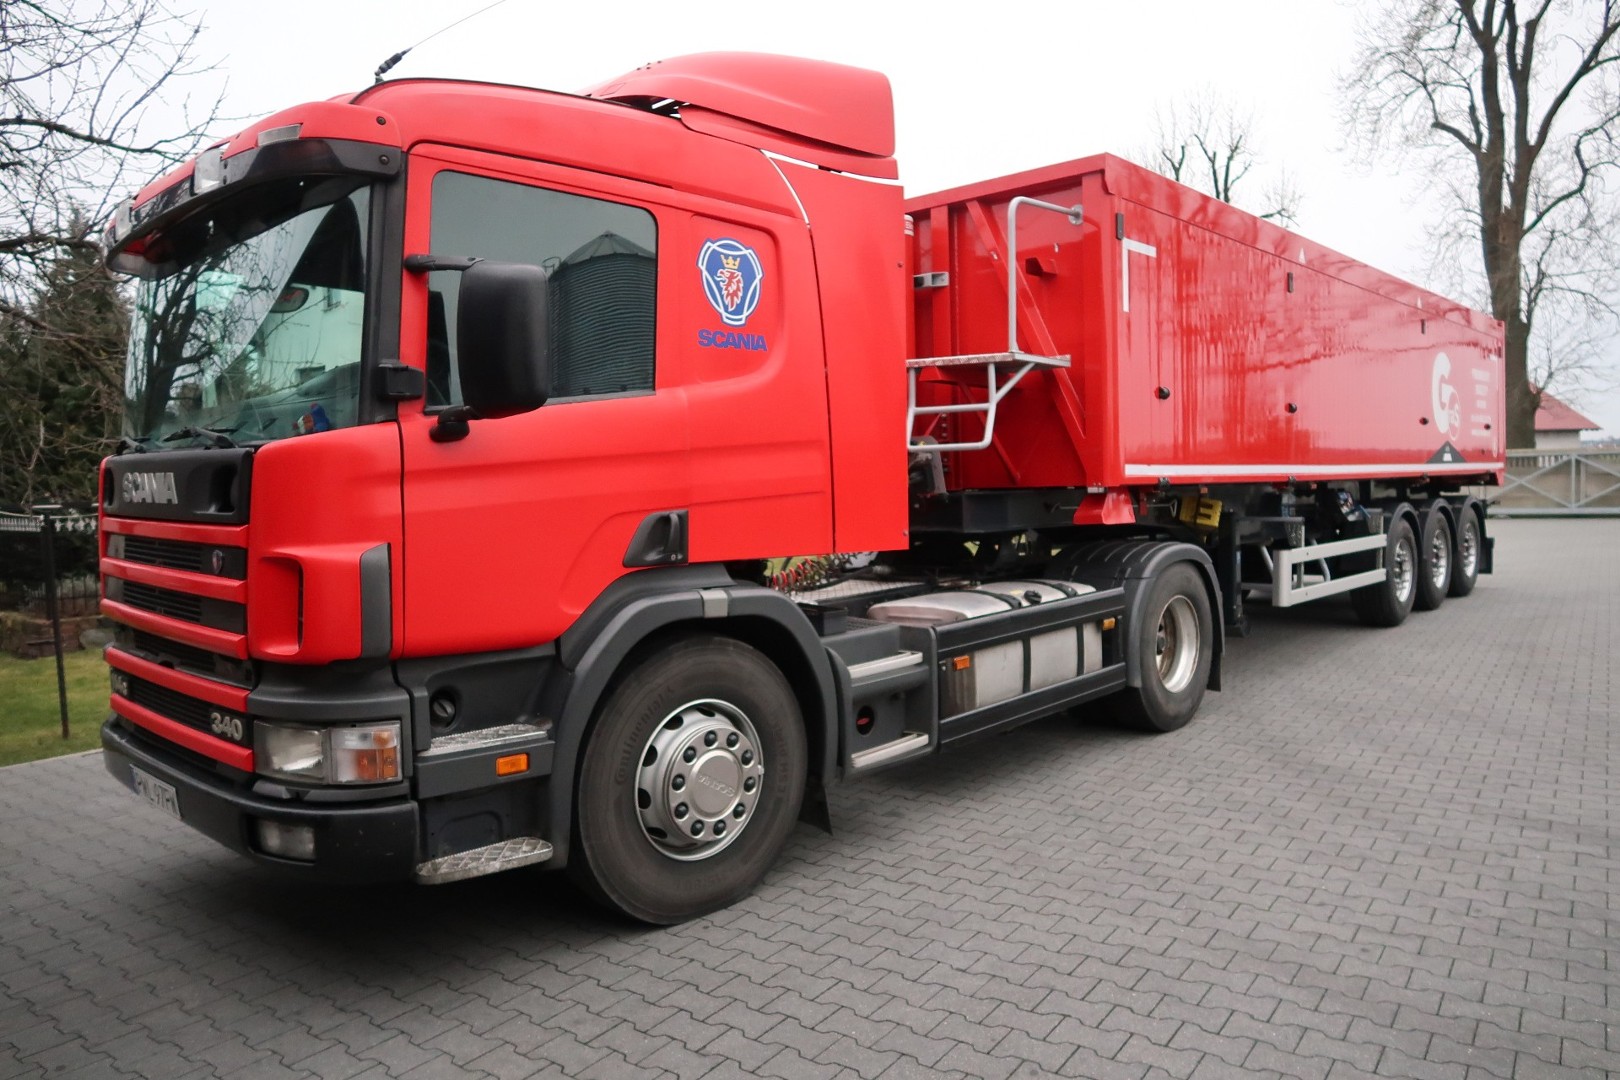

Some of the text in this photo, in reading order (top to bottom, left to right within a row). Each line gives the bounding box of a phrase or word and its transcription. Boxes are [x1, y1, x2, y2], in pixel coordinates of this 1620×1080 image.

[697, 329, 768, 351] SCANIA
[122, 472, 178, 504] SCANIA
[210, 712, 243, 741] 340
